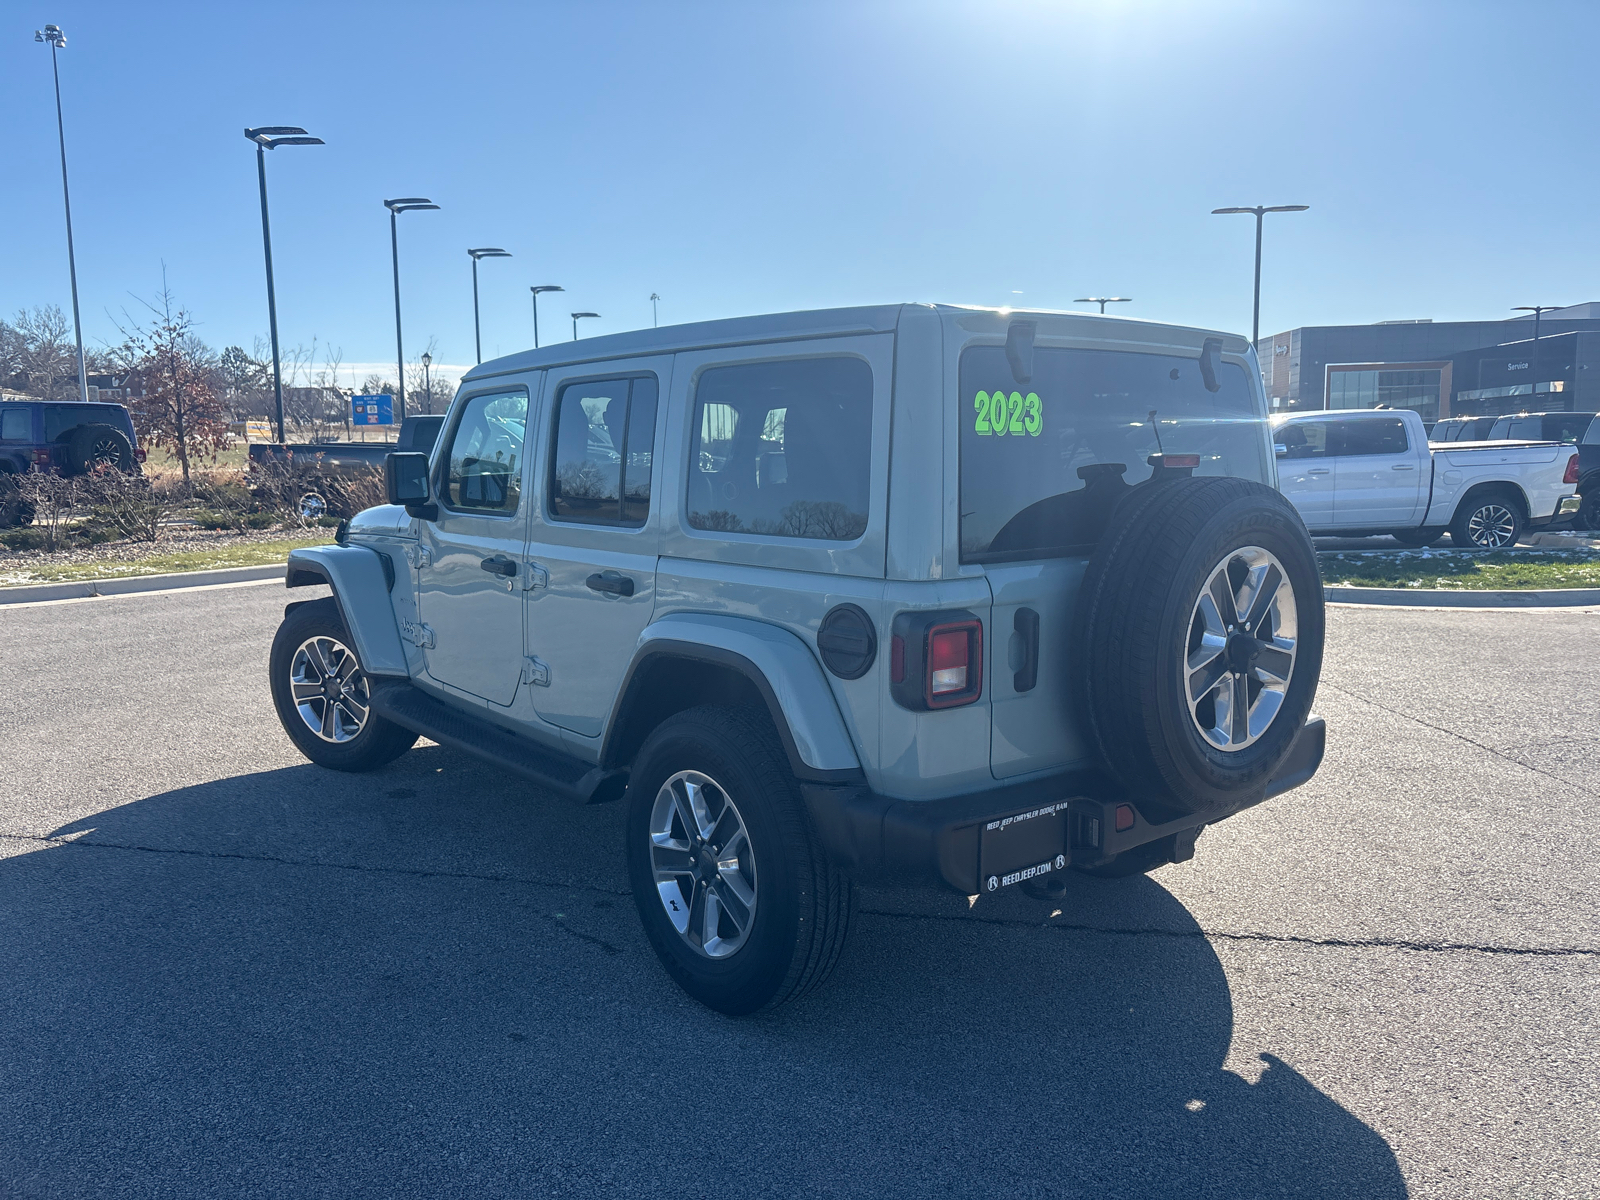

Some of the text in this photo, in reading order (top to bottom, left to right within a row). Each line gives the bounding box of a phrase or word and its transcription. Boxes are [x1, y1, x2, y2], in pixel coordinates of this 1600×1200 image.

[1507, 361, 1529, 371] Service
[974, 390, 1043, 436] 2023
[986, 802, 1068, 831] REED JEEP CHRYSLER DODGE RAM
[1002, 862, 1052, 887] REEDJEEP.COM
